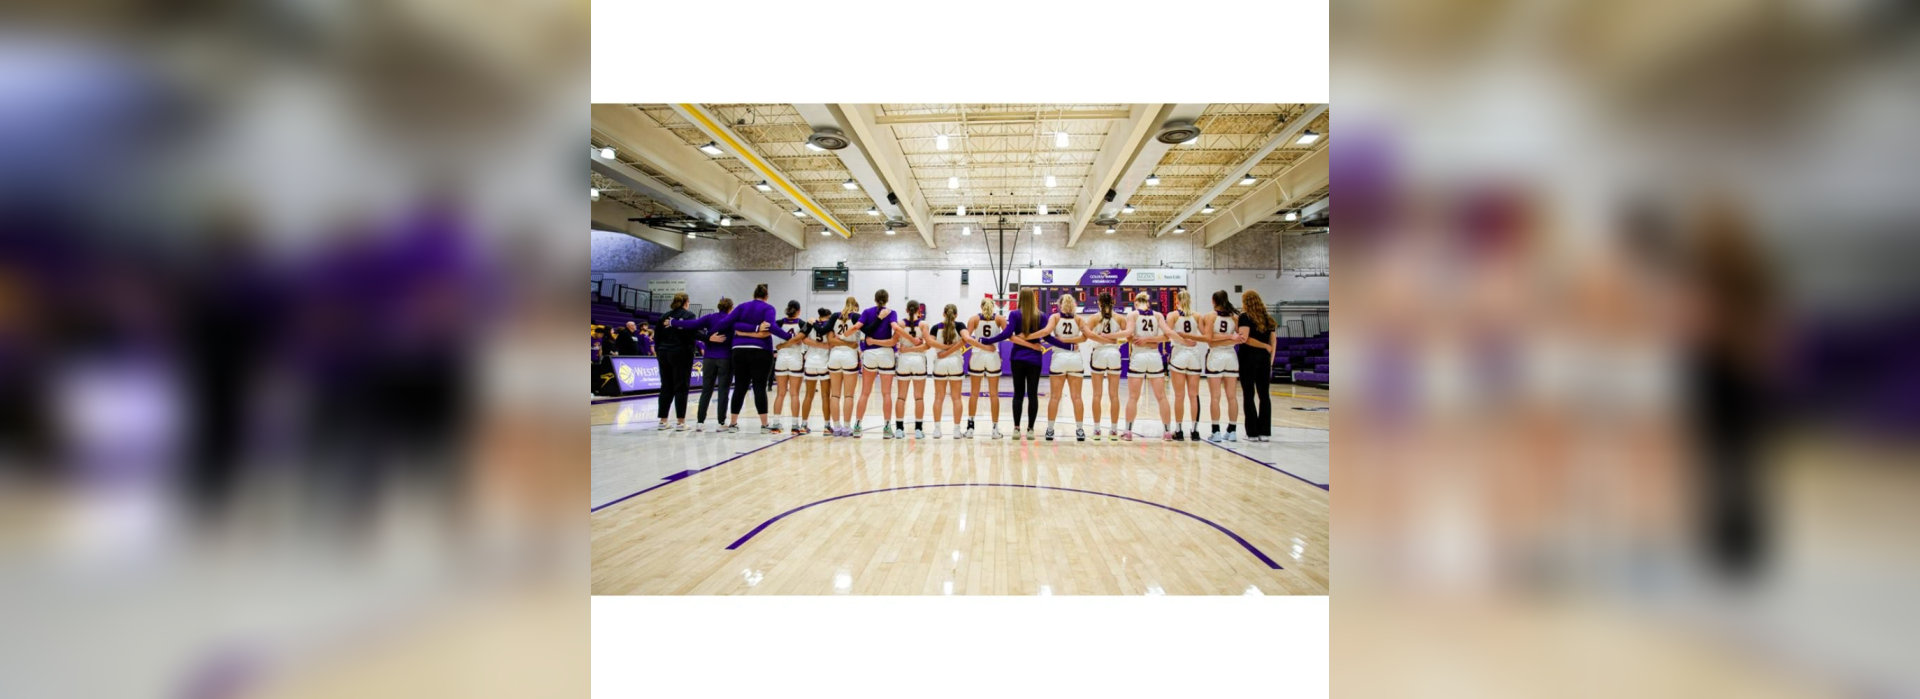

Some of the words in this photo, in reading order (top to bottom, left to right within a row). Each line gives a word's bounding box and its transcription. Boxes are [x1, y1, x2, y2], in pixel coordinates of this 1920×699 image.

[982, 325, 992, 338] 6
[1062, 322, 1073, 335] 22
[1142, 319, 1154, 332] 24
[1183, 320, 1192, 333] 8
[1219, 321, 1228, 333] 9
